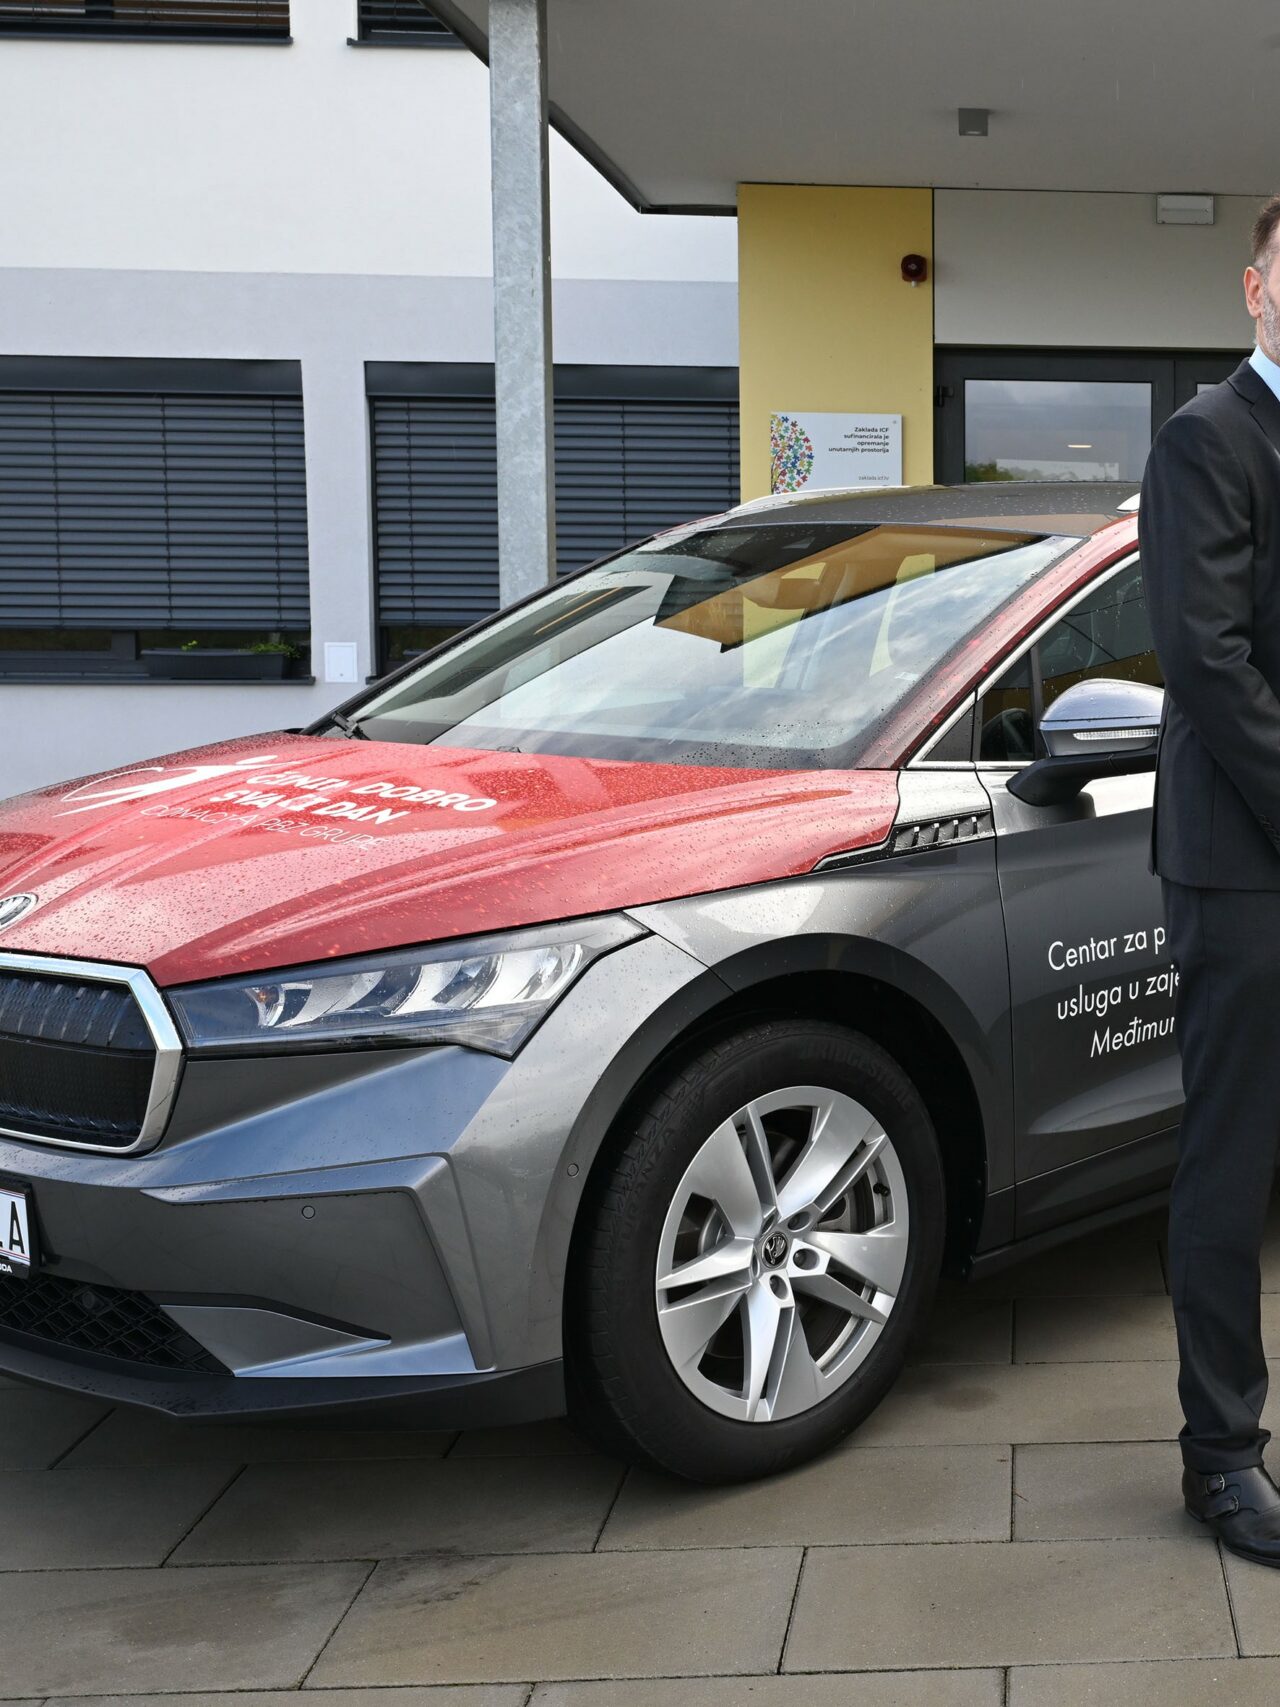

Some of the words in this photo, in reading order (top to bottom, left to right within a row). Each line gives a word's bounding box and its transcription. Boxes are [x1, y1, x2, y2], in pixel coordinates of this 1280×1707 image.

[350, 781, 498, 812] DOBRO
[311, 801, 411, 825] DAN
[252, 818, 310, 833] PBZ
[300, 825, 389, 850] GRUPE
[1048, 937, 1117, 971] Centar
[1123, 930, 1147, 954] za
[1057, 983, 1122, 1020] usluga
[1128, 981, 1139, 1000] u
